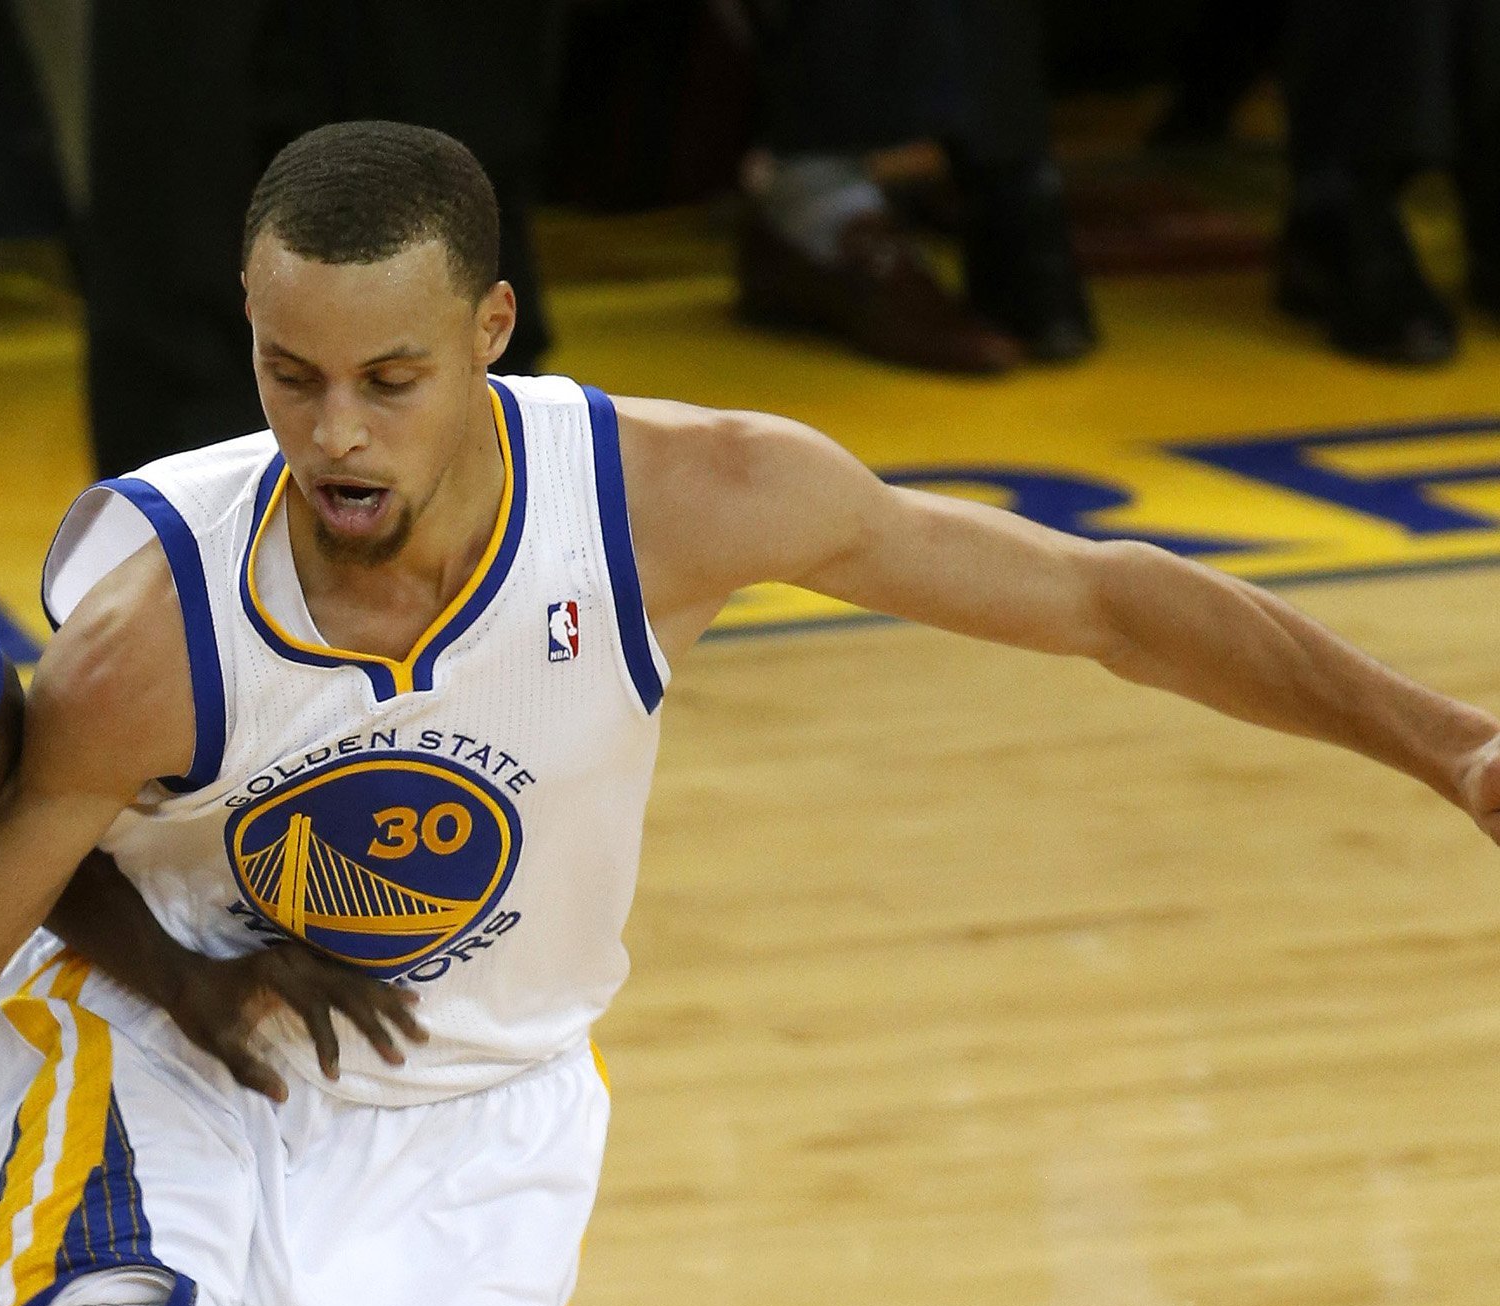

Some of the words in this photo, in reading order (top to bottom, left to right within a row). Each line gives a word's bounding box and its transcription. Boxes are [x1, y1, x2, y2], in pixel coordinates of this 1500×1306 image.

[225, 729, 397, 808] GOLDEN
[417, 730, 536, 795] STATE
[366, 802, 473, 860] 30
